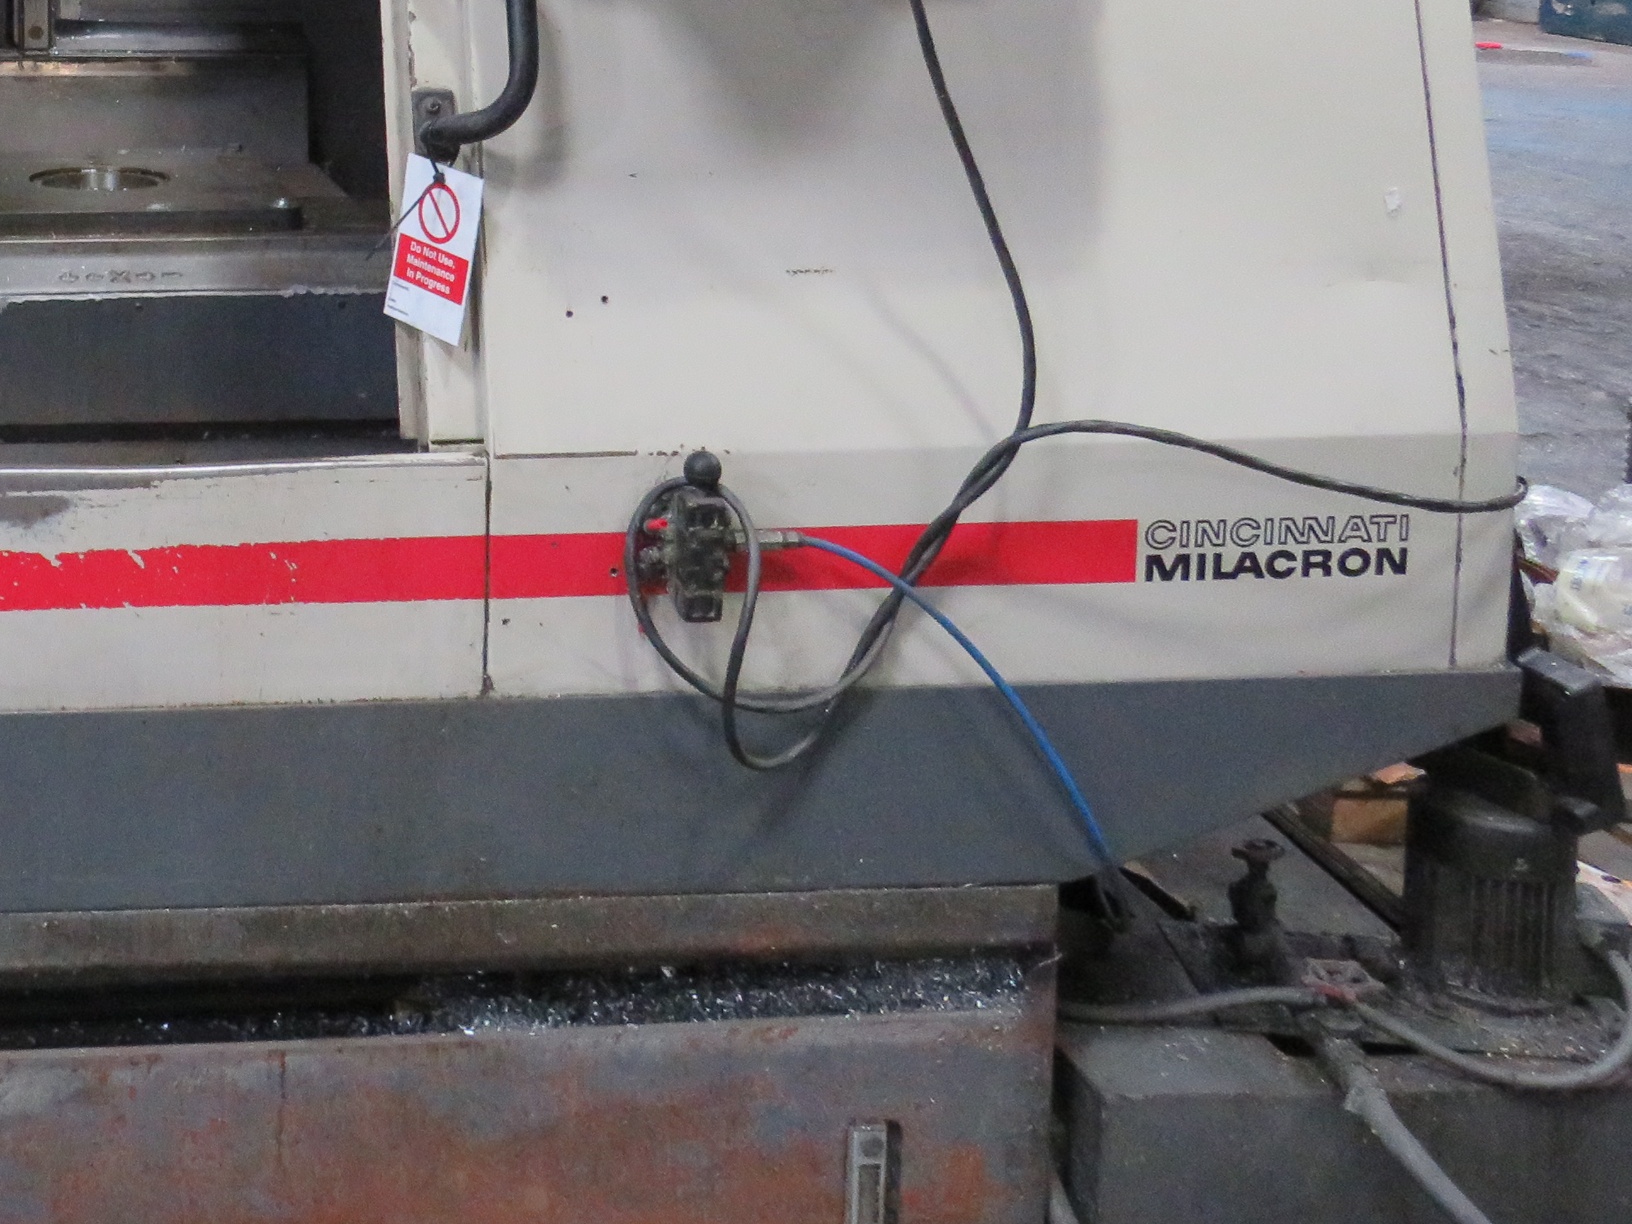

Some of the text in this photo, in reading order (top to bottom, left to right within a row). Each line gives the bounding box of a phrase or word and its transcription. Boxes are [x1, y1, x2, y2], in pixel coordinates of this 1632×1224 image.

[410, 240, 421, 254] Do
[422, 246, 436, 261] Not
[406, 253, 455, 283] Maintenance
[415, 271, 451, 295] Progress
[1144, 514, 1410, 550] CINCINNATI
[1144, 547, 1408, 582] MILACRON
